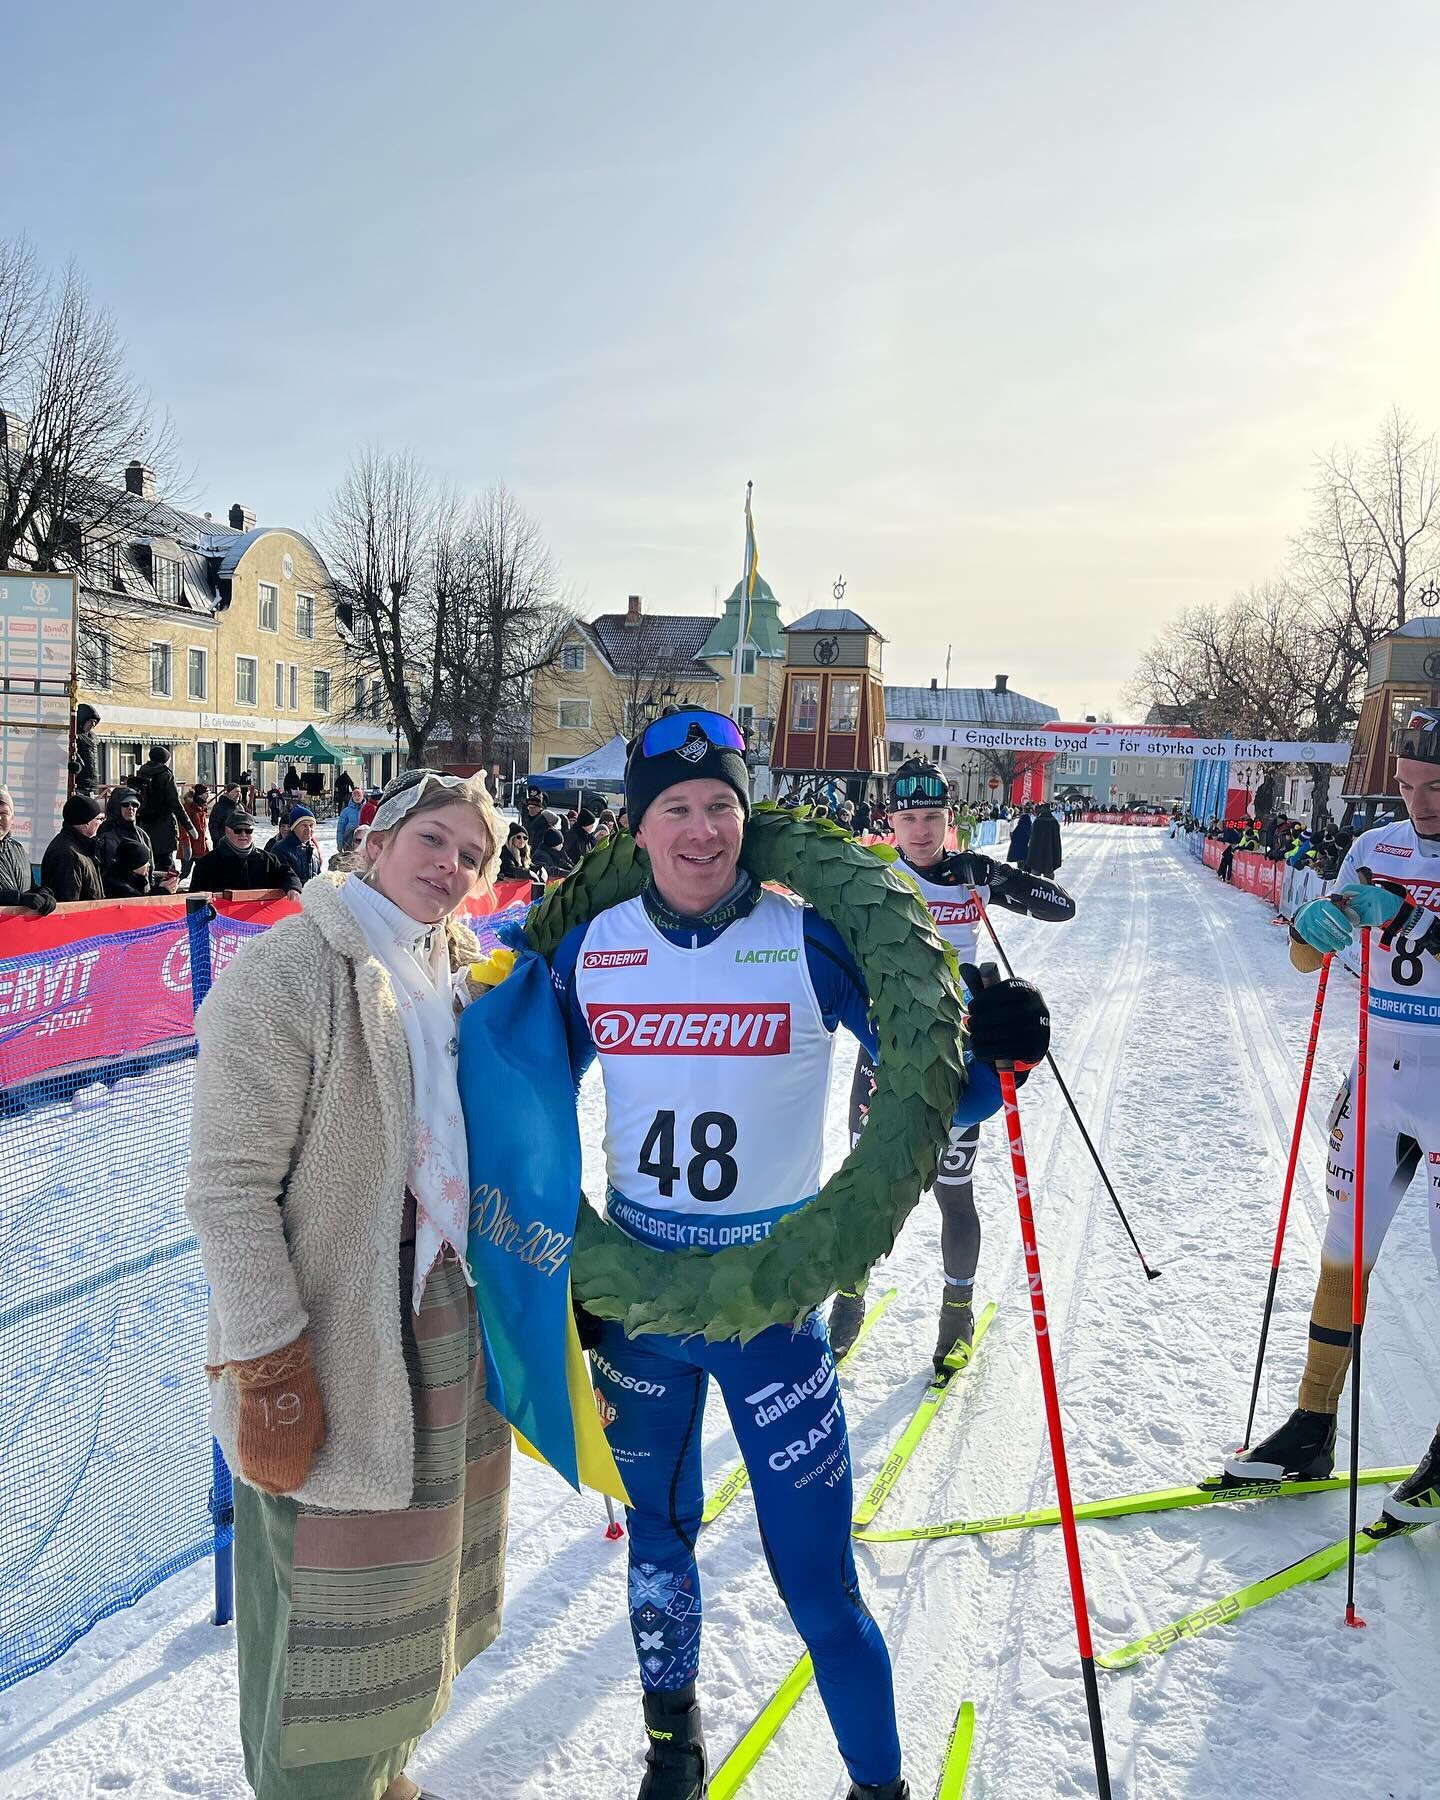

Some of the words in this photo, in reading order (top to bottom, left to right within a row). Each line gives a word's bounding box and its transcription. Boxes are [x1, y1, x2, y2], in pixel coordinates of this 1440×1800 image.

[273, 754, 299, 763] ARCTIC
[299, 755, 315, 763] CAT
[966, 730, 1047, 748] Engelbrekts
[1054, 735, 1088, 753] bygd
[1119, 739, 1140, 753] för
[1147, 741, 1194, 756] styrka
[1202, 743, 1226, 756] och
[1234, 743, 1275, 758] frihet
[601, 950, 647, 967] ENERVIT
[735, 948, 799, 963] LACTIGO
[631, 1012, 787, 1048] ENERVIT
[637, 1109, 739, 1203] 48
[1002, 1099, 1030, 1200] WAY
[615, 1201, 772, 1246] ENGELBREKTSLOPPET
[768, 1399, 842, 1472] CRAFT
[825, 1455, 849, 1488] viati
[866, 1453, 903, 1506] FISCHER
[1211, 1485, 1282, 1501] FISCHER
[911, 1513, 1027, 1538] FISCHER
[1145, 1597, 1240, 1653] FISCHER
